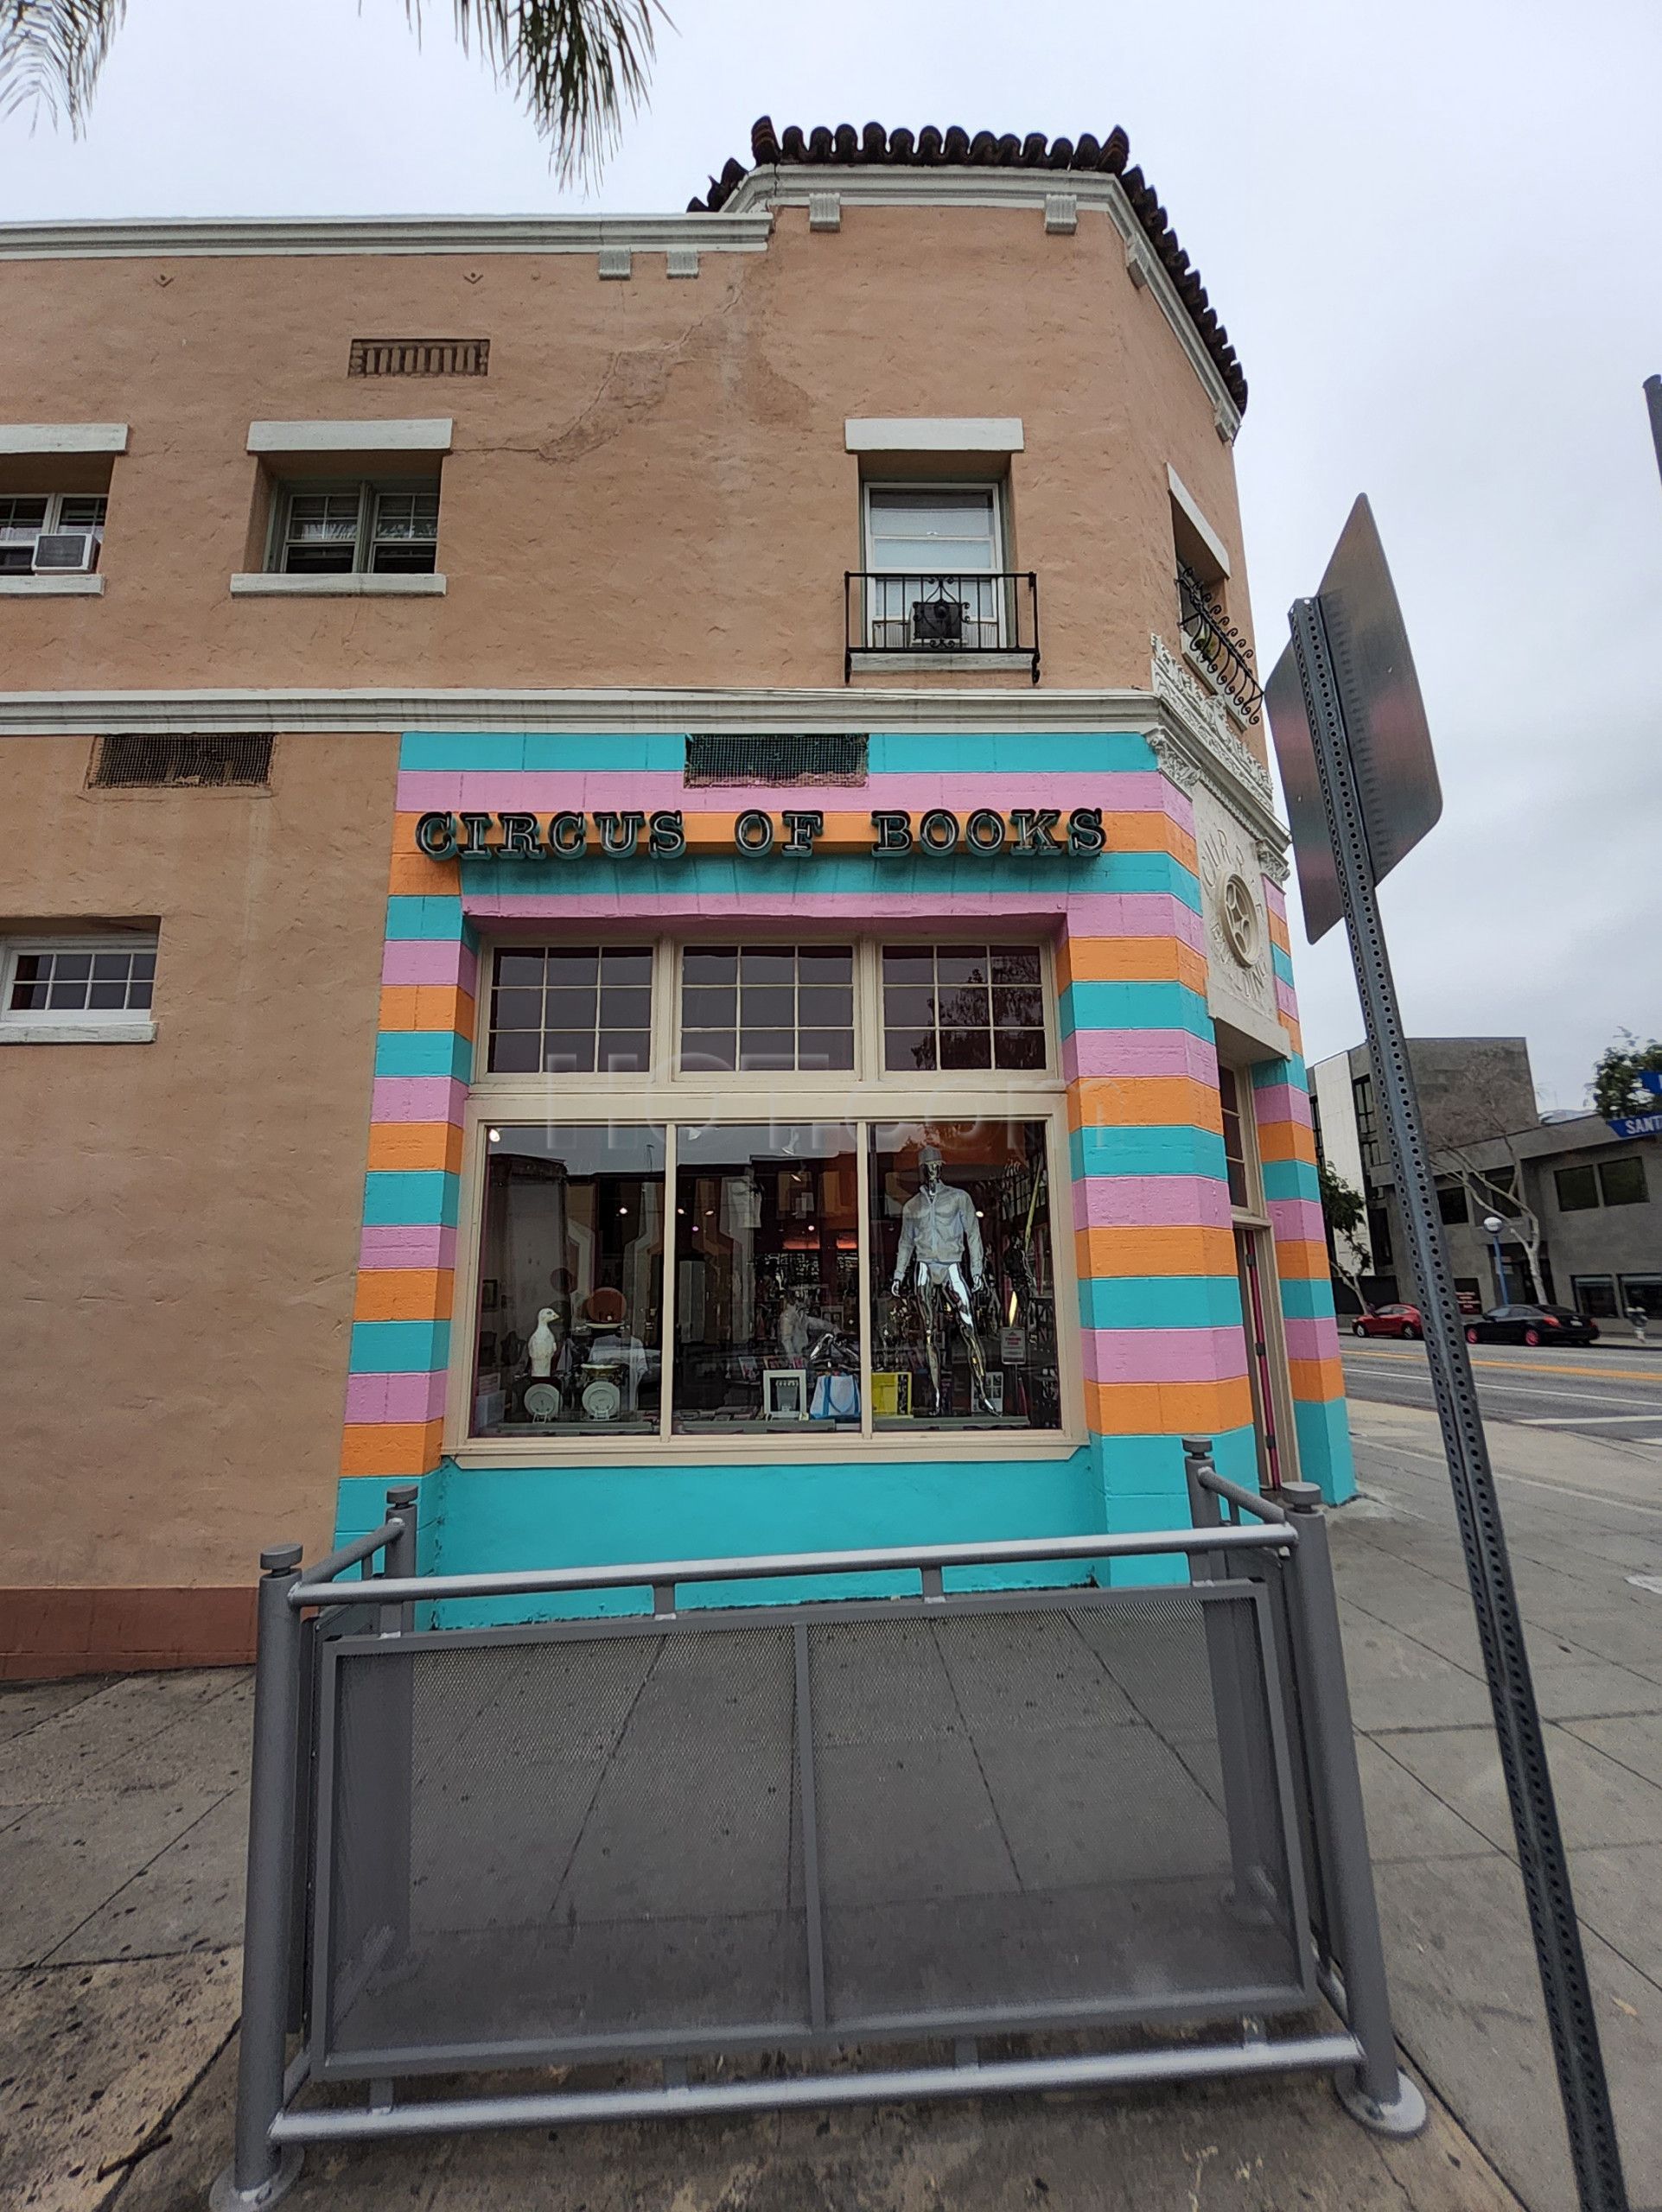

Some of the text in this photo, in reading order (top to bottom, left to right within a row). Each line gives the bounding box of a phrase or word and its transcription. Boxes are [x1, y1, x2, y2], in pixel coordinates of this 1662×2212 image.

[415, 807, 1107, 860] CIRCUS OF BOOKS
